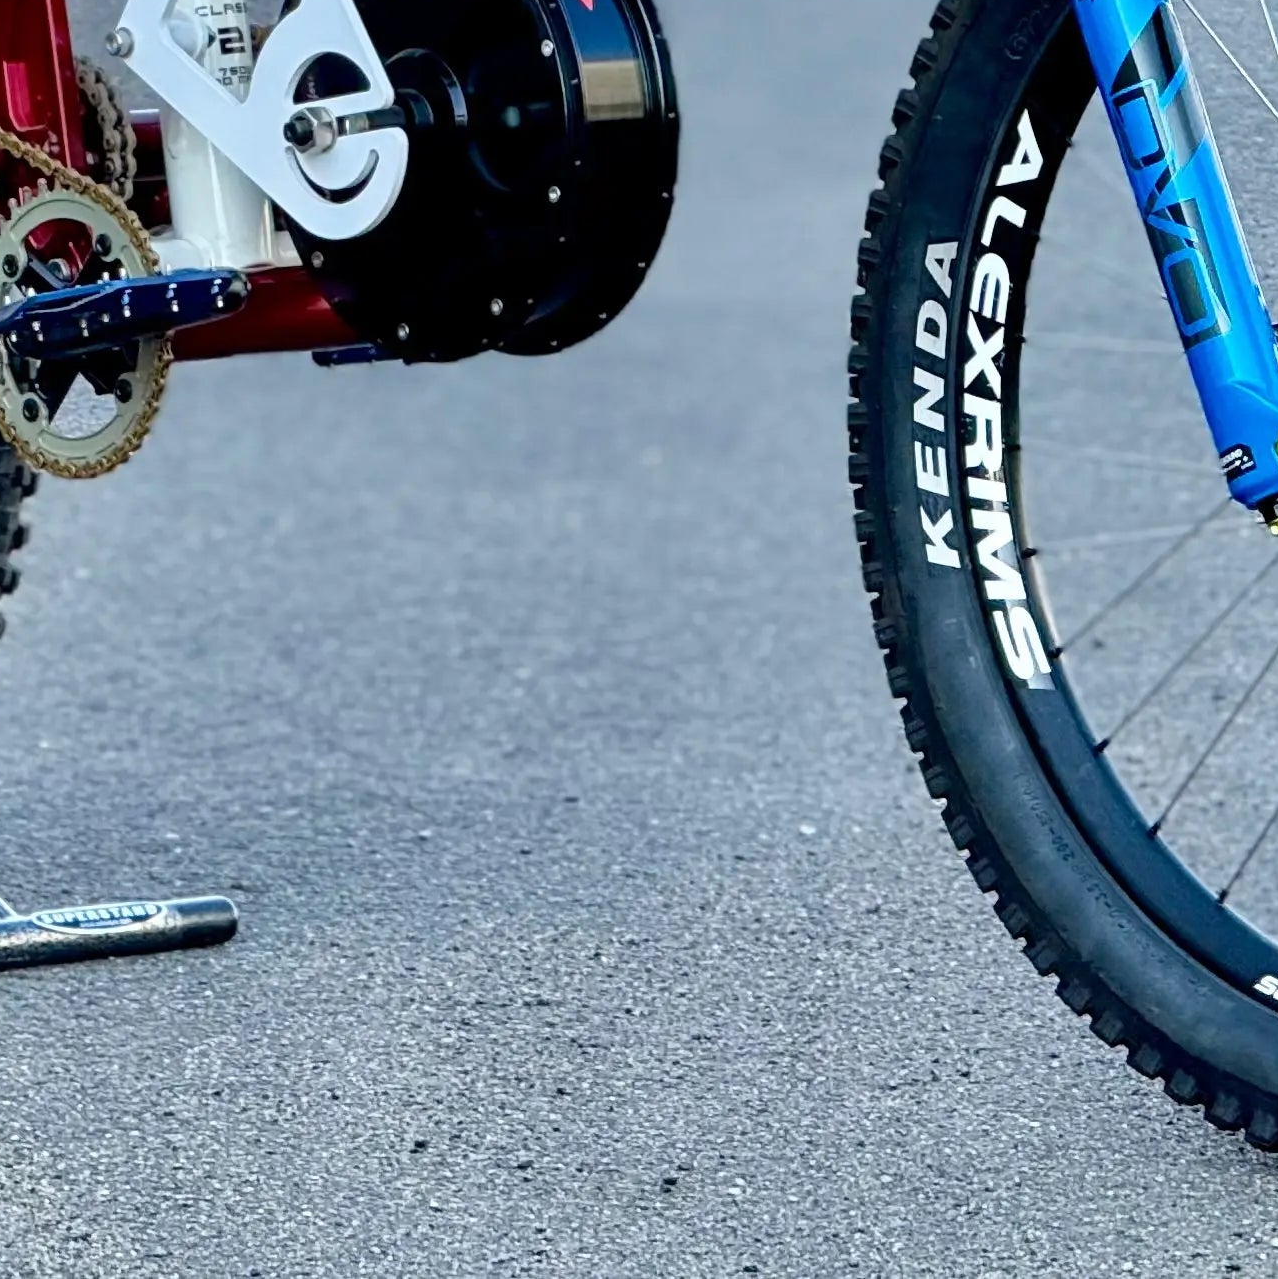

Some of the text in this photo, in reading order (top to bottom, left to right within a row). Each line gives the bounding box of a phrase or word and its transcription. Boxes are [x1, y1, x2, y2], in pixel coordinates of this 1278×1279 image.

[217, 26, 247, 56] 2
[1113, 80, 1223, 338] DVO
[912, 240, 961, 569] KENDA
[964, 108, 1057, 690] ALEXRIMS
